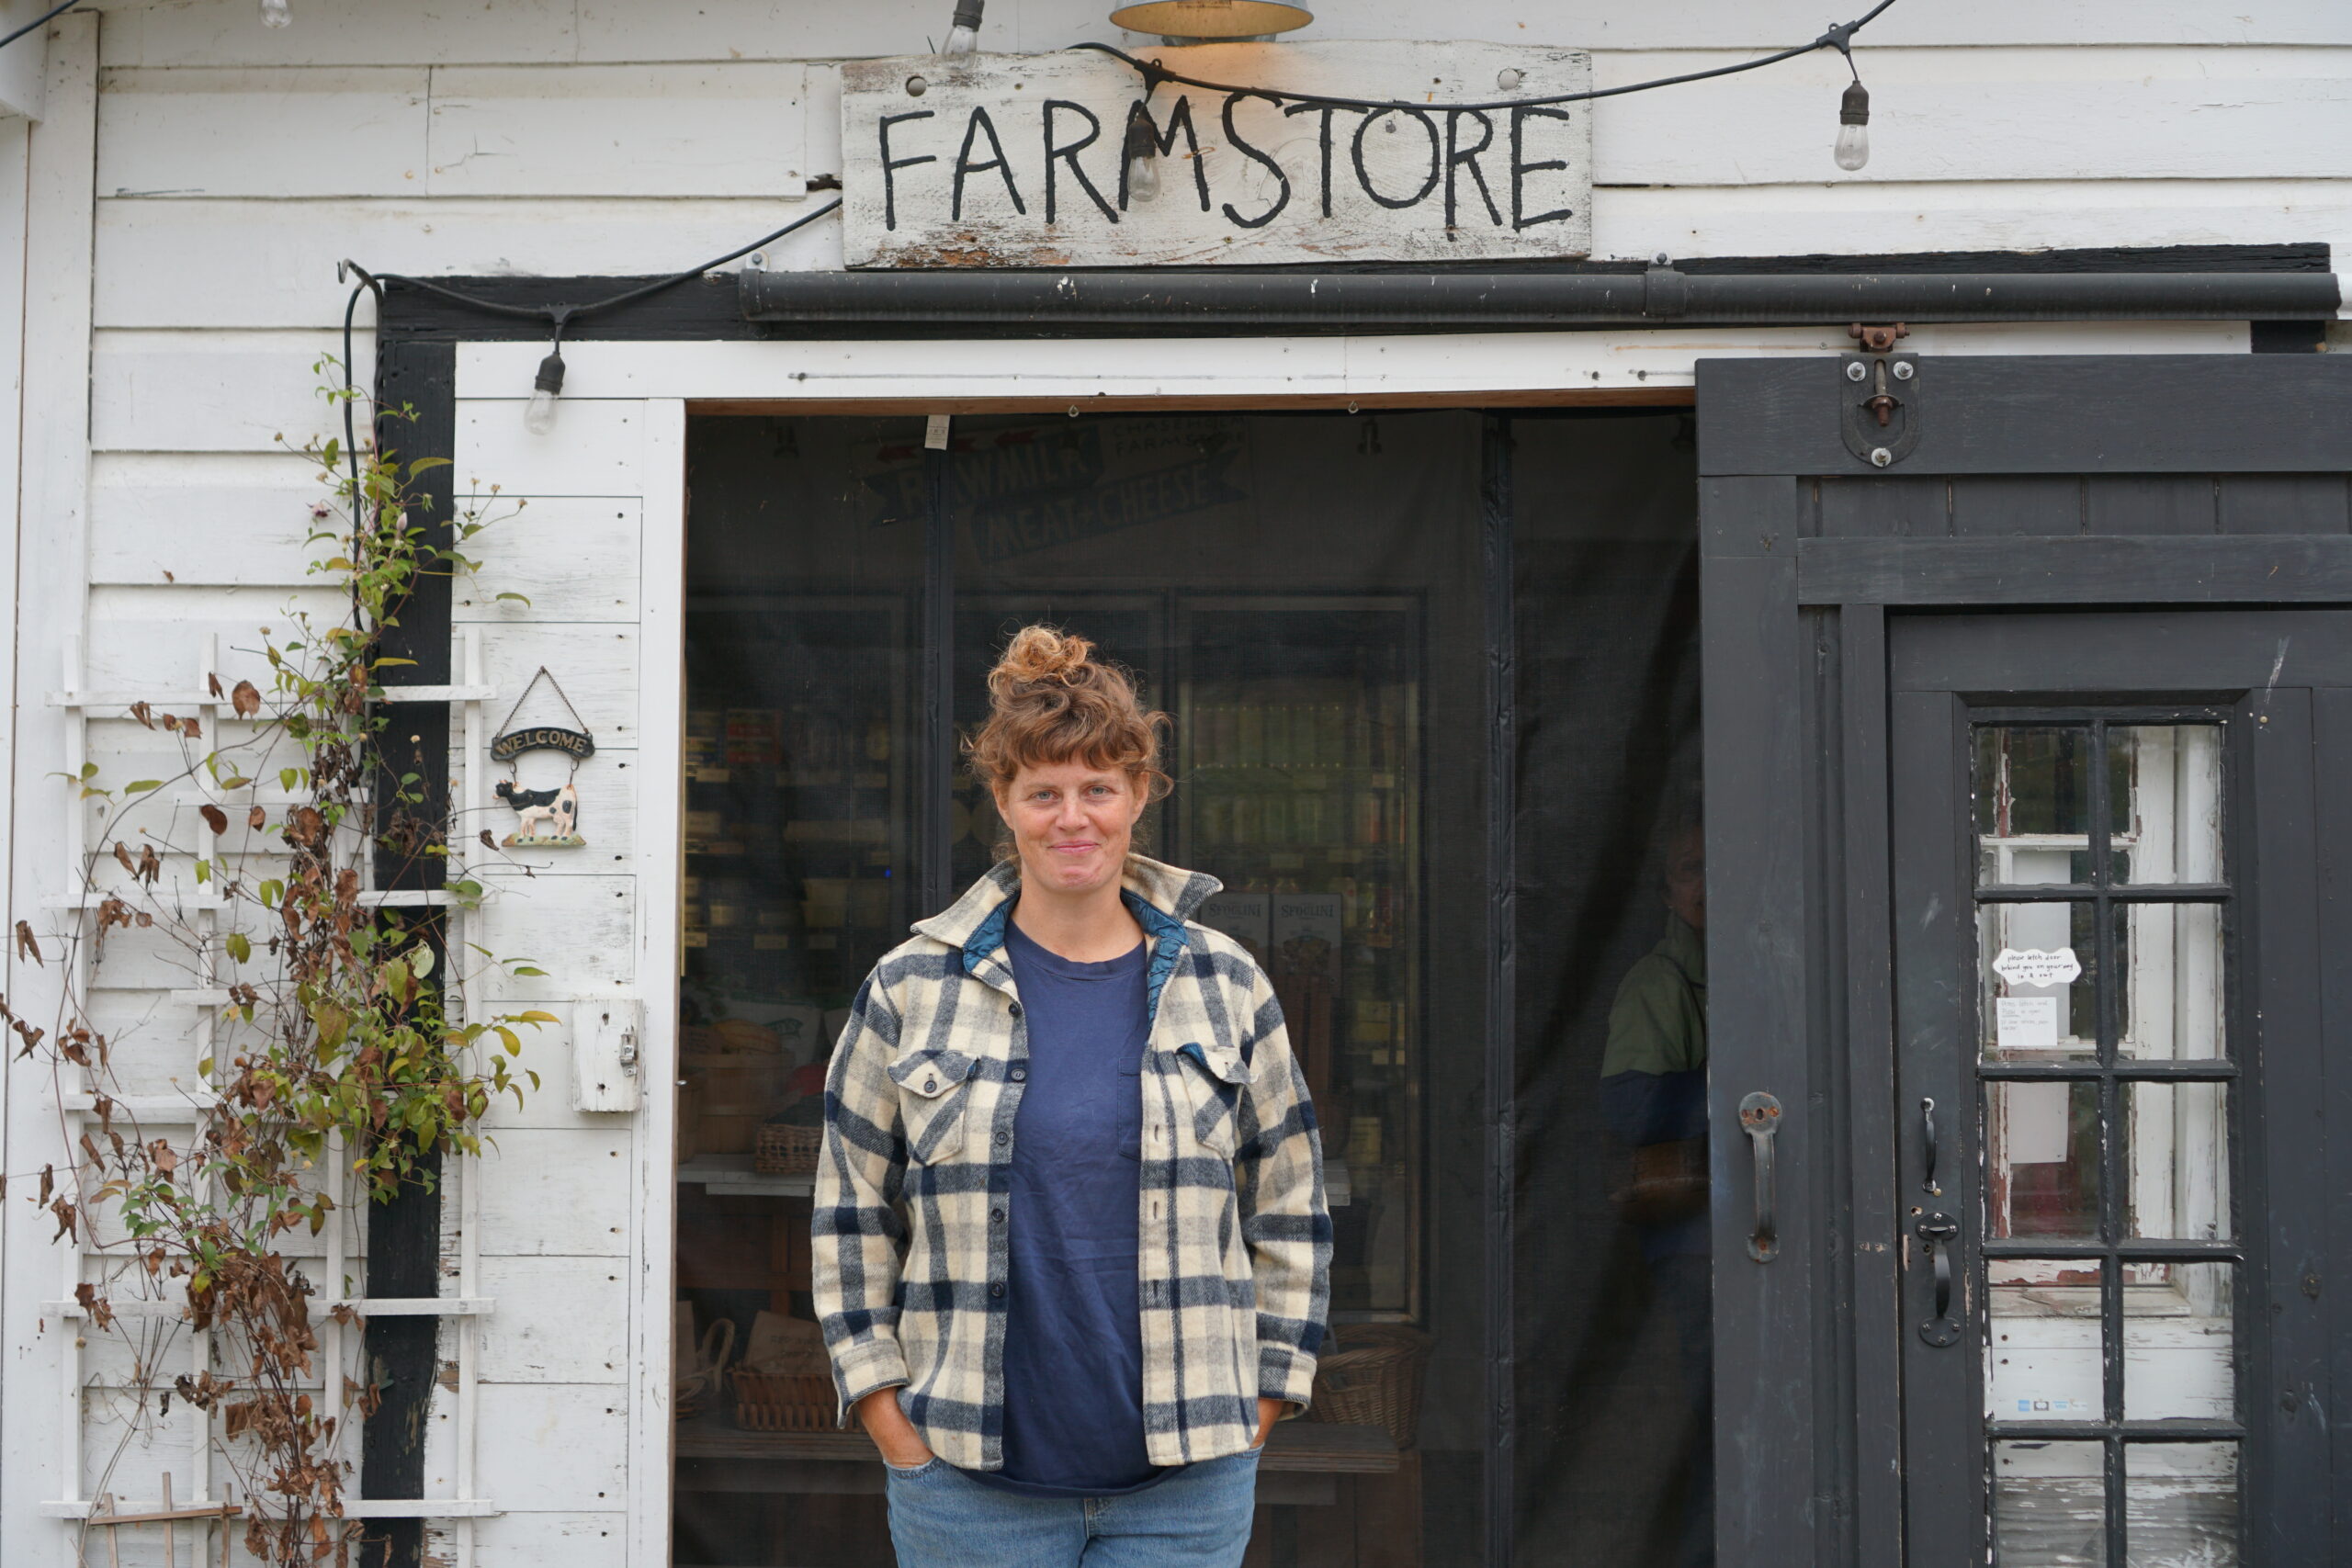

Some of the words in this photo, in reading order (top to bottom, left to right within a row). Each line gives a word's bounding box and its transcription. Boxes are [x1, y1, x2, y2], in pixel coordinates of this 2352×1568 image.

[987, 497, 1080, 558] MEAT
[1098, 462, 1208, 526] CHEESE
[495, 730, 587, 755] WELCOME
